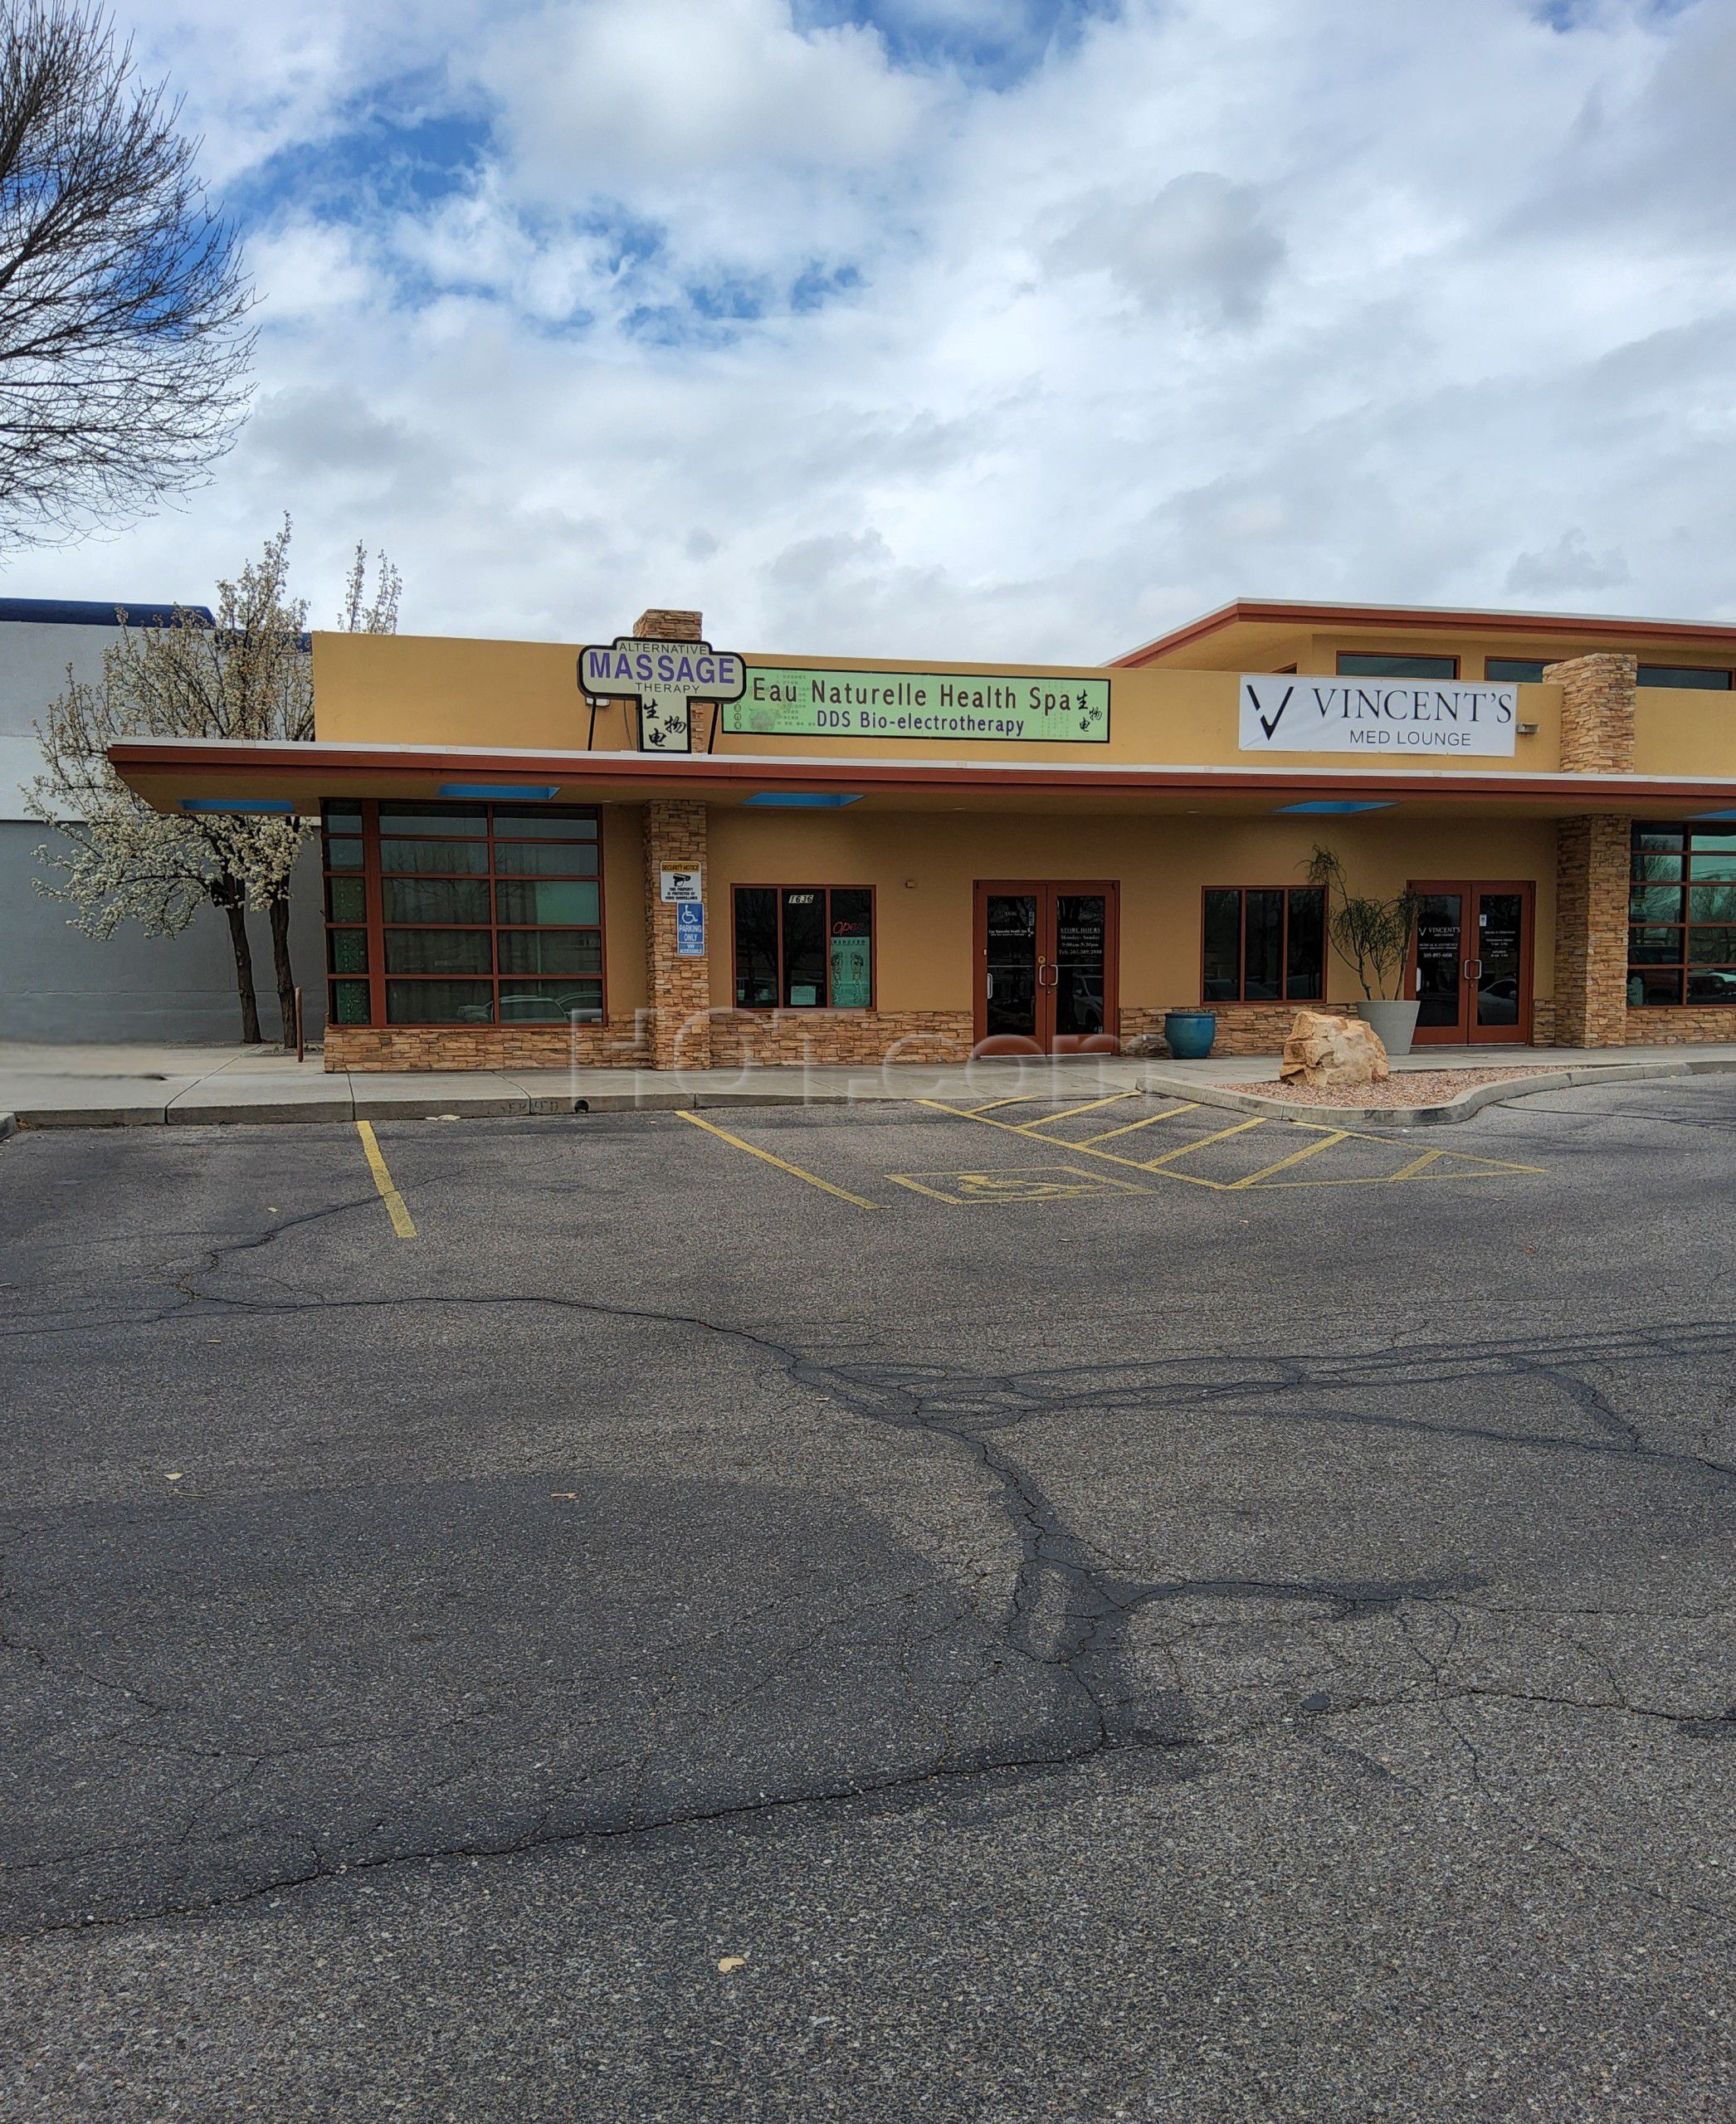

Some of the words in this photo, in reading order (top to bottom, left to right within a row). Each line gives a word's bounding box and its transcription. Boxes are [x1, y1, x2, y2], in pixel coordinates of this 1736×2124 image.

[619, 642, 707, 655] ALTERNATIVE
[589, 651, 735, 684] MASSAGE
[635, 682, 700, 694] THERAPY
[753, 677, 797, 702] Eau
[812, 680, 927, 706] Naturelle
[940, 684, 1017, 709] Health
[1029, 686, 1070, 716] Spa
[1311, 688, 1513, 723] VINCENT'S
[817, 710, 851, 728] DDS
[861, 711, 1024, 737] Bio-electrotherapy
[1349, 730, 1391, 744] MED
[1397, 731, 1471, 746] LOUNGE
[679, 924, 702, 933] PARKING
[684, 933, 698, 942] ONLY
